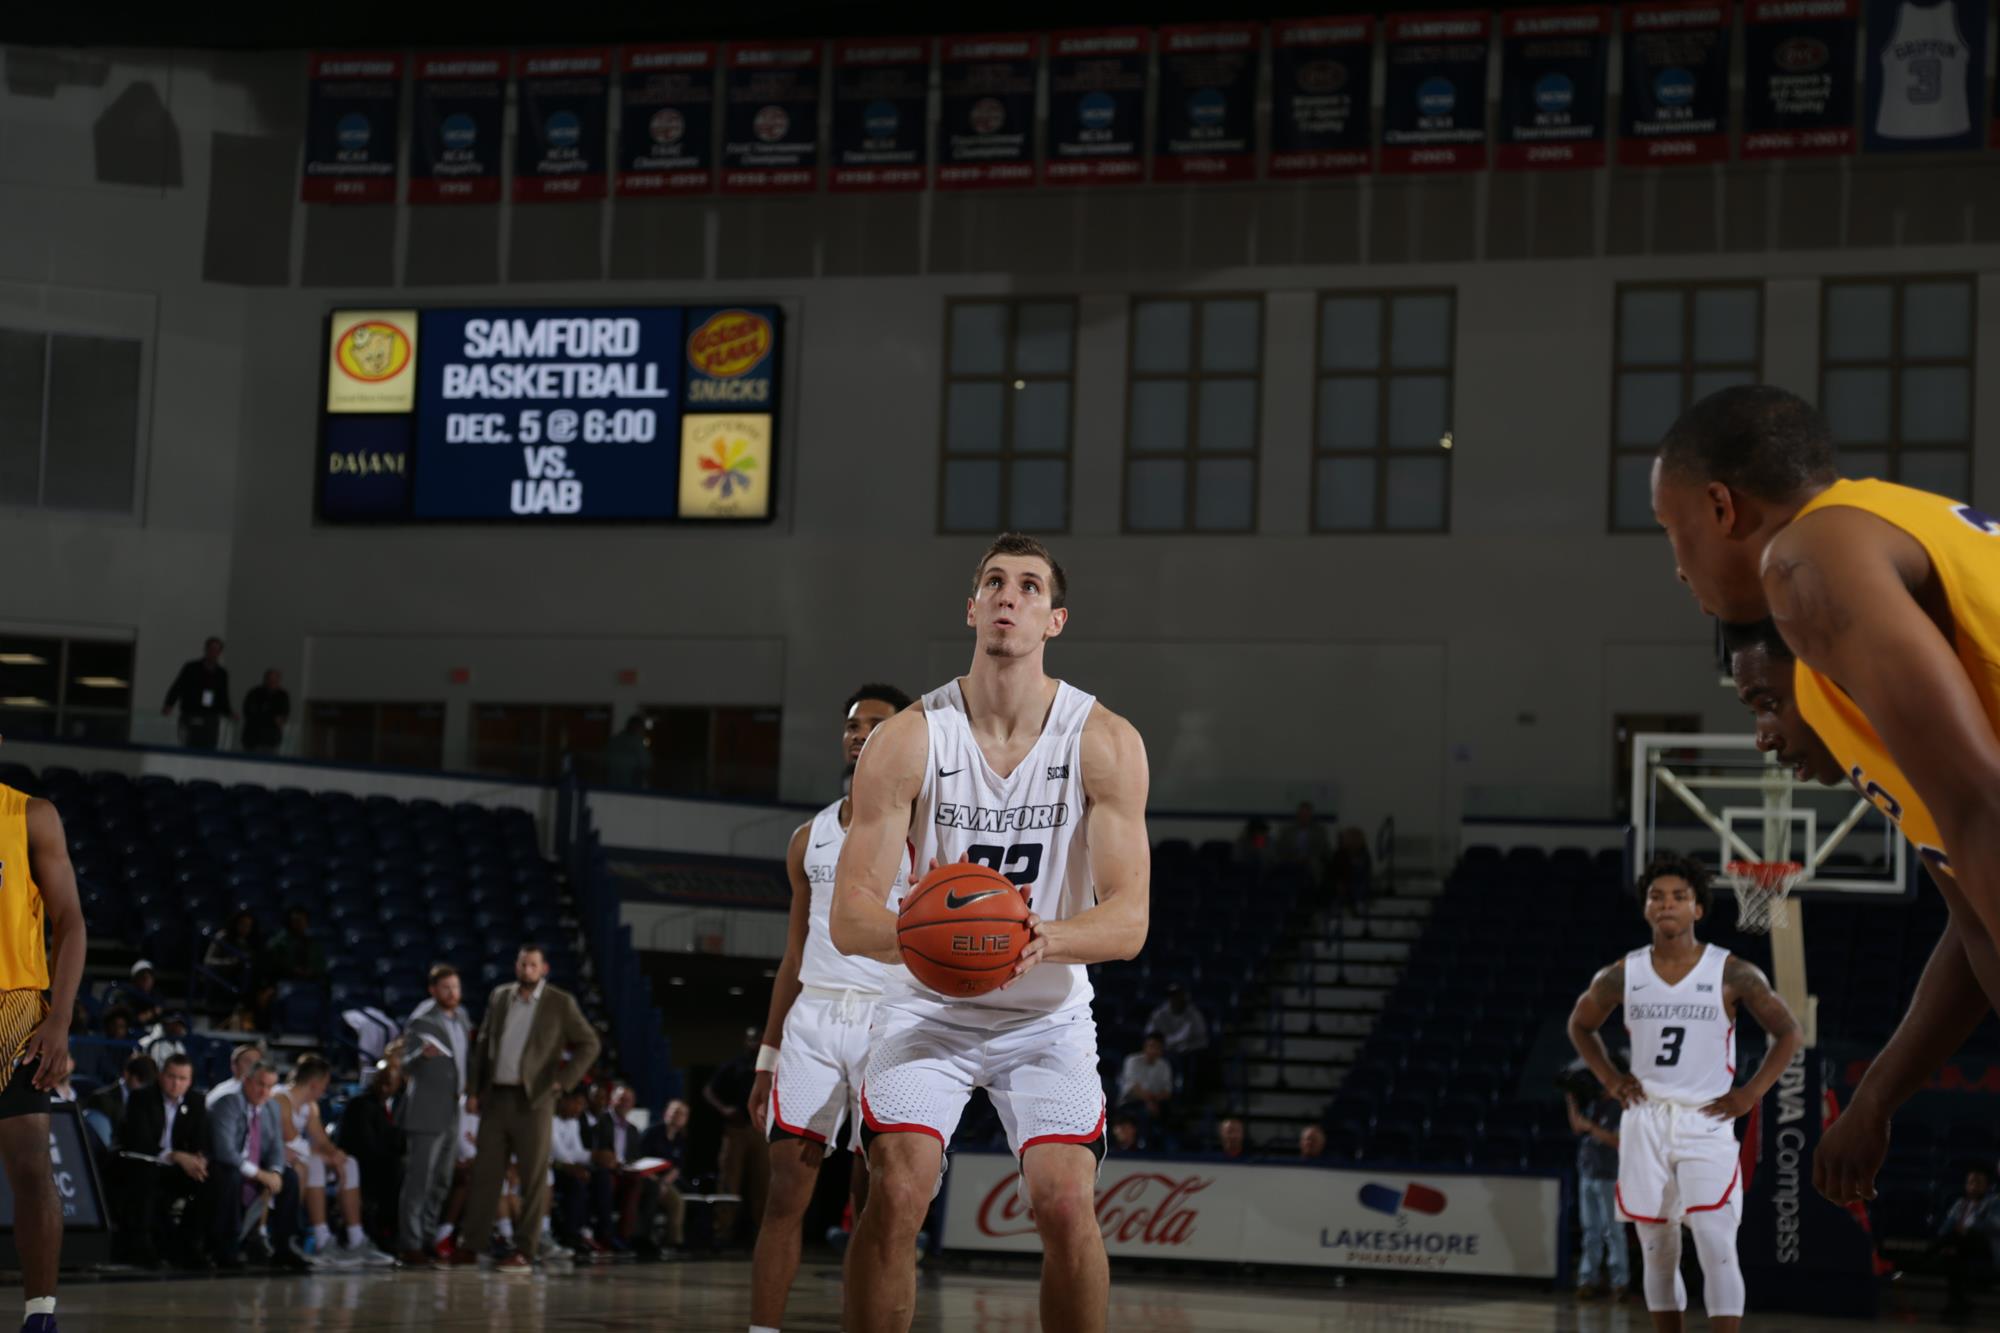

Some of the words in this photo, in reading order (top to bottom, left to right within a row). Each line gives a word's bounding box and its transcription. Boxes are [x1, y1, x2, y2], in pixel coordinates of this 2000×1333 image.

[1908, 60, 1942, 104] 3
[463, 318, 640, 359] SAMFORD
[442, 363, 669, 399] BASKETBALL
[687, 379, 769, 402] SNACKS
[446, 410, 511, 443] DEC.
[518, 409, 541, 443] 5
[546, 410, 578, 443] @
[583, 409, 657, 443] 6:00
[524, 445, 574, 479] VS.
[511, 480, 583, 514] UAB
[935, 803, 1069, 833] SAMFORD
[952, 935, 1010, 951] ELITE
[1630, 1004, 1718, 1021] SAMFORD
[1654, 1026, 1686, 1067] 3
[1773, 1128, 1806, 1264] Compass
[1321, 1229, 1480, 1255] LAKESHORE
